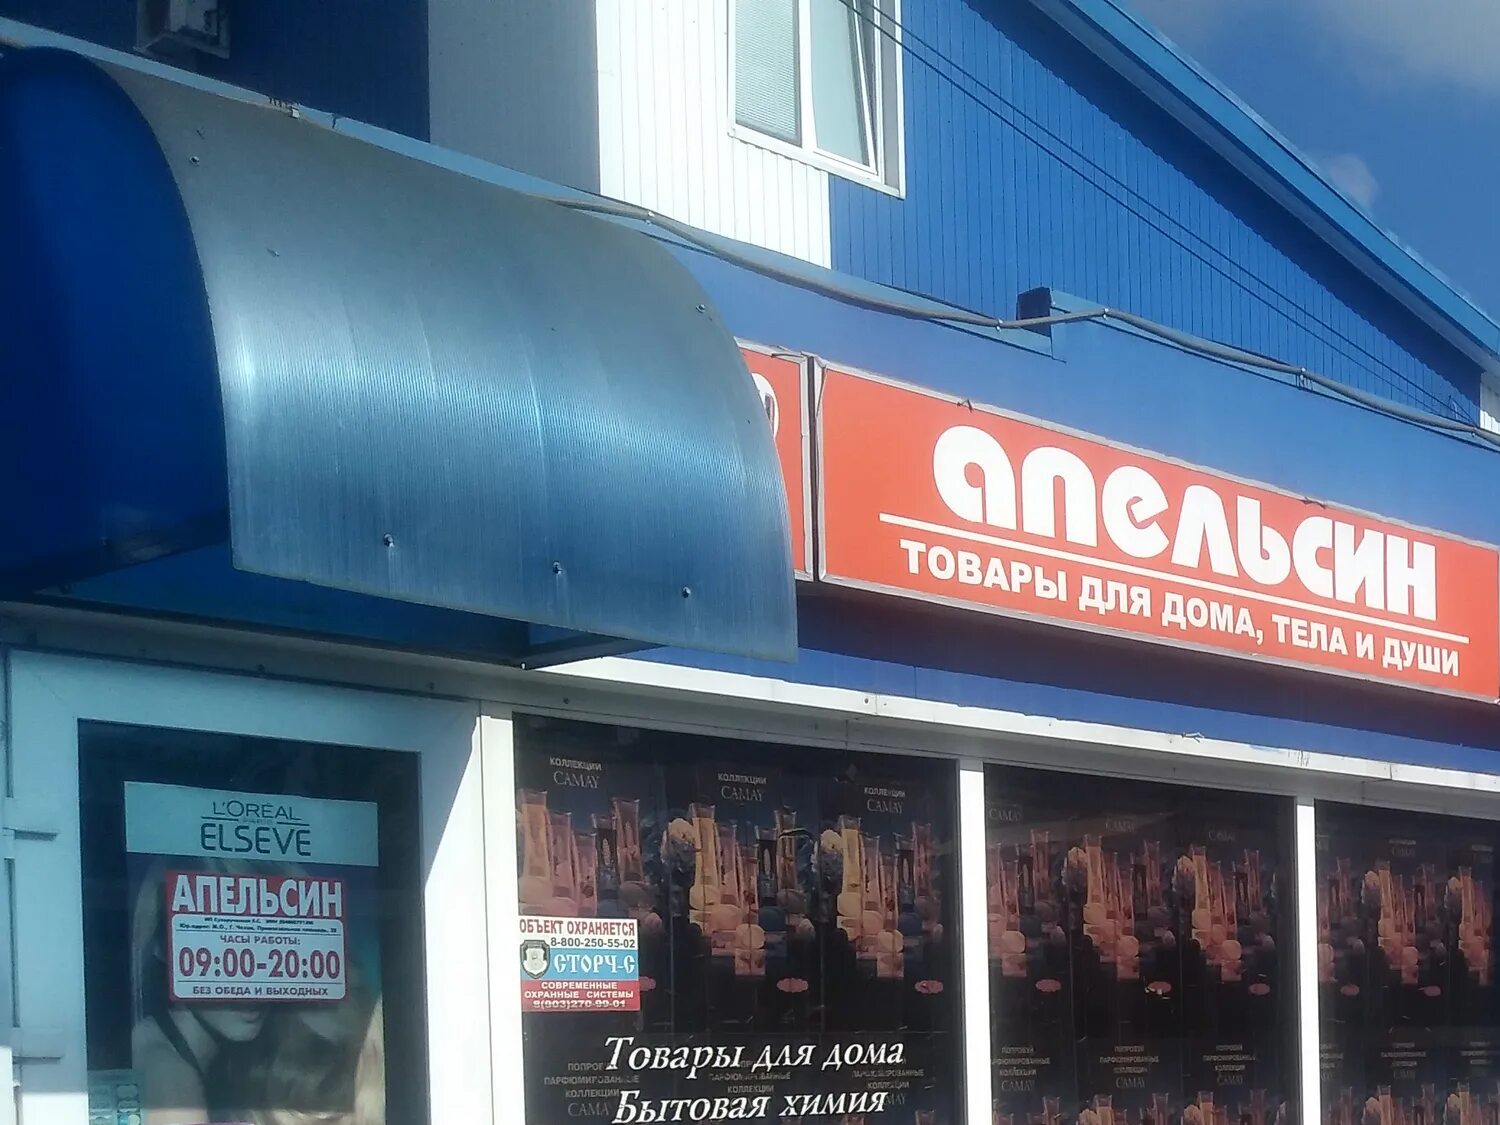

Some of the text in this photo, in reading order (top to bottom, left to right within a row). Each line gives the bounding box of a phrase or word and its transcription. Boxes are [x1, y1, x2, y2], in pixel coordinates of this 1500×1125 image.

[900, 539, 1459, 676] ТОВАРЫ ДЛЯ ДОМА, ТЕЛА И ДУШИ
[549, 756, 602, 771] КОЛЛЕКЦИИ
[553, 770, 600, 789] CAMAY
[721, 785, 764, 802] CAMAY
[867, 799, 904, 814] CAMAY
[201, 823, 311, 857] ELSEVE
[171, 874, 343, 917] АПЕЛЬСИН
[519, 919, 635, 936] ОБЪЕКТ ОХРАНЯЕТСЯ
[220, 935, 301, 945] ЧАСЫ РАБОТЫ:
[550, 937, 636, 949] 8-800-250-55-02
[179, 947, 340, 979] 09:00-20:00
[193, 986, 328, 996] БЕЗ ОБЕДА И ВЫХОДНЫХ
[541, 981, 618, 990] СОВРЕМЕННЫЕ
[524, 990, 634, 999] ОХРАННЫЕ СИСТЕМЫ
[605, 1037, 904, 1079] Товары для дома
[567, 1102, 610, 1117] CAMA
[612, 1090, 889, 1124] Бытовая химия
